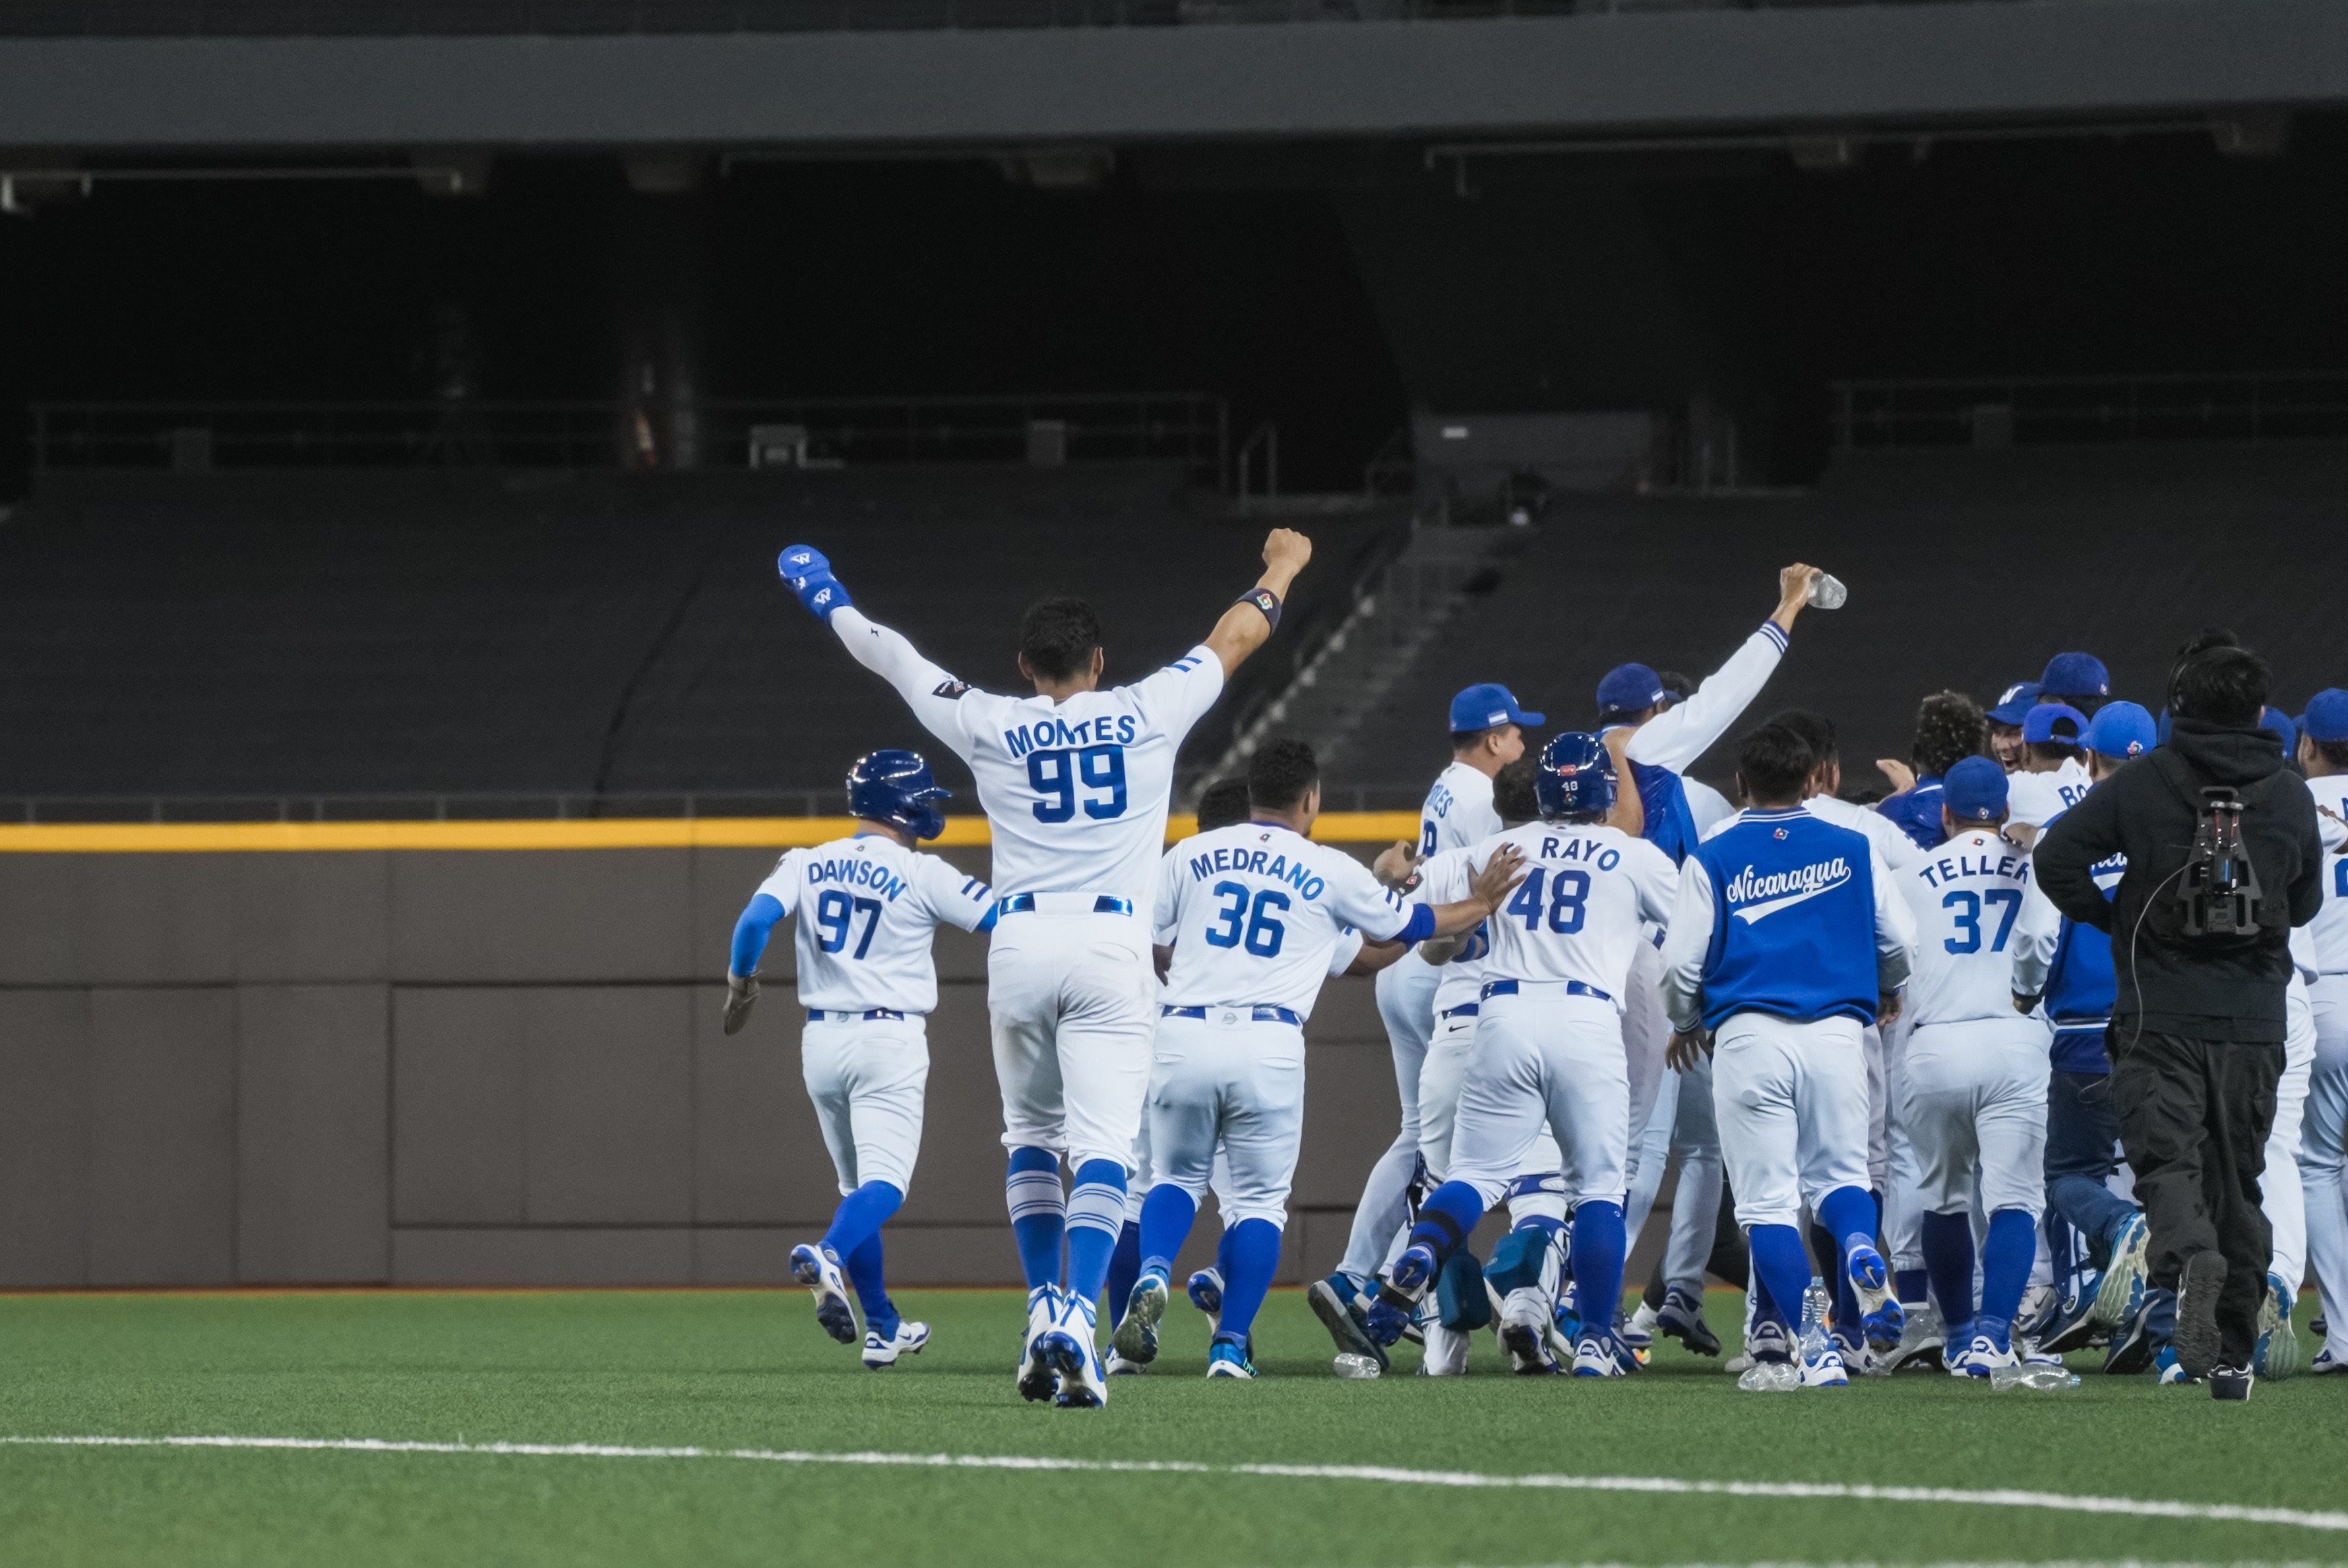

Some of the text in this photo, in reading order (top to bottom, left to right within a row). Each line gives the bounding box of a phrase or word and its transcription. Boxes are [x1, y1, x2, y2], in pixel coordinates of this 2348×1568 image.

[1004, 715, 1136, 758] MONTES
[1026, 743, 1127, 824] 99
[1561, 781, 1578, 791] 48
[808, 859, 907, 903] DAWSON
[1190, 848, 1324, 901] MEDRANO
[1541, 837, 1621, 872] RAYO
[1727, 857, 1851, 903] Nicaragua
[817, 889, 882, 960] 97
[1206, 880, 1291, 958] 36
[1506, 868, 1591, 934] 48
[1942, 889, 2023, 955] 37
